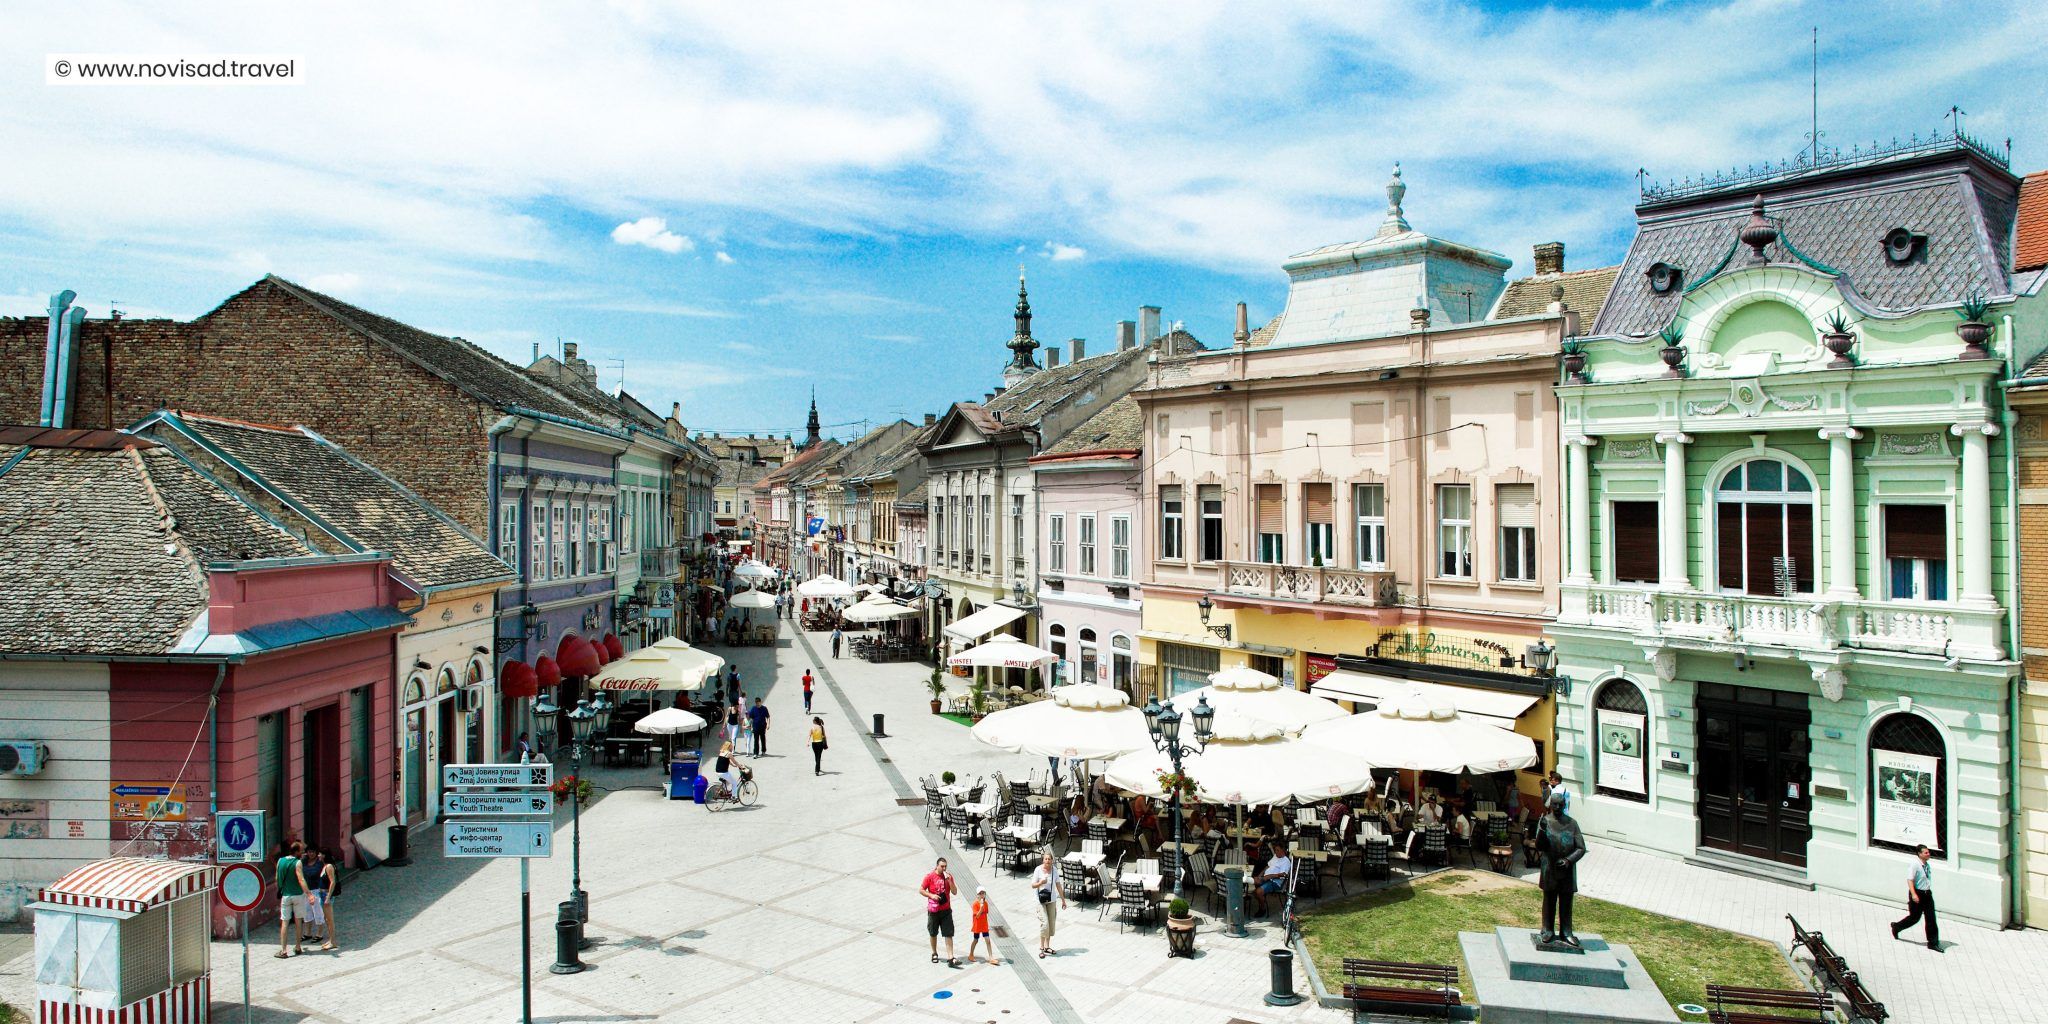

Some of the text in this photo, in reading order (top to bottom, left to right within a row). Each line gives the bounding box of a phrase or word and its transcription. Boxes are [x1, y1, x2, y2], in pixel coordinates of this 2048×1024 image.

[1395, 632, 1420, 654] alla
[1004, 659, 1029, 668] AMSTEL
[459, 768, 475, 776] Змај
[501, 769, 520, 777] улица
[459, 777, 475, 785] Zmaj
[459, 826, 498, 834] Туристички
[459, 835, 503, 843] инфо-центар
